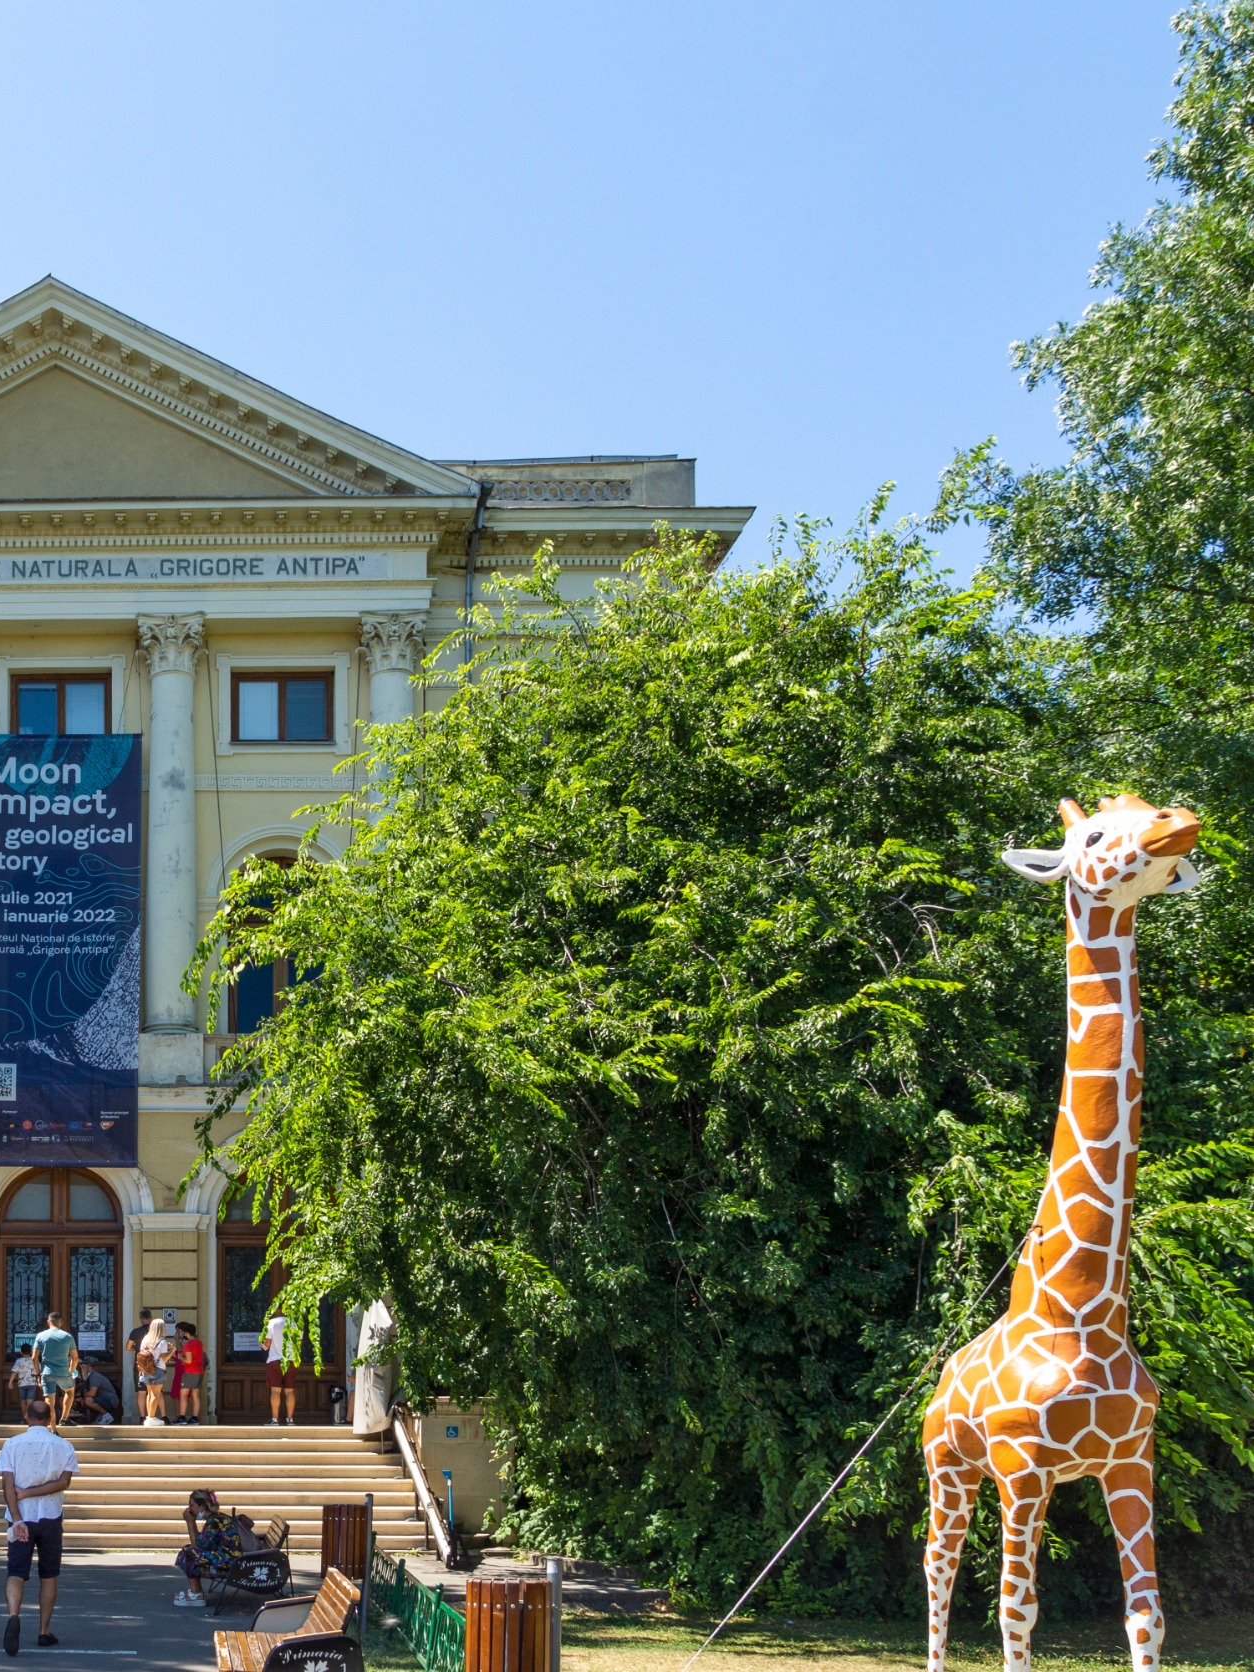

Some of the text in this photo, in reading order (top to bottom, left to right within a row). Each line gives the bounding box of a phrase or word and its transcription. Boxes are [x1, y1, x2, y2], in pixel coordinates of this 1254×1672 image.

[4, 823, 133, 850] geological
[34, 891, 73, 905] 2021
[3, 909, 69, 923] ianuarie
[73, 909, 116, 922] 2022
[67, 933, 81, 942] de
[83, 932, 115, 942] Istorie
[276, 1568, 281, 1577] 1
